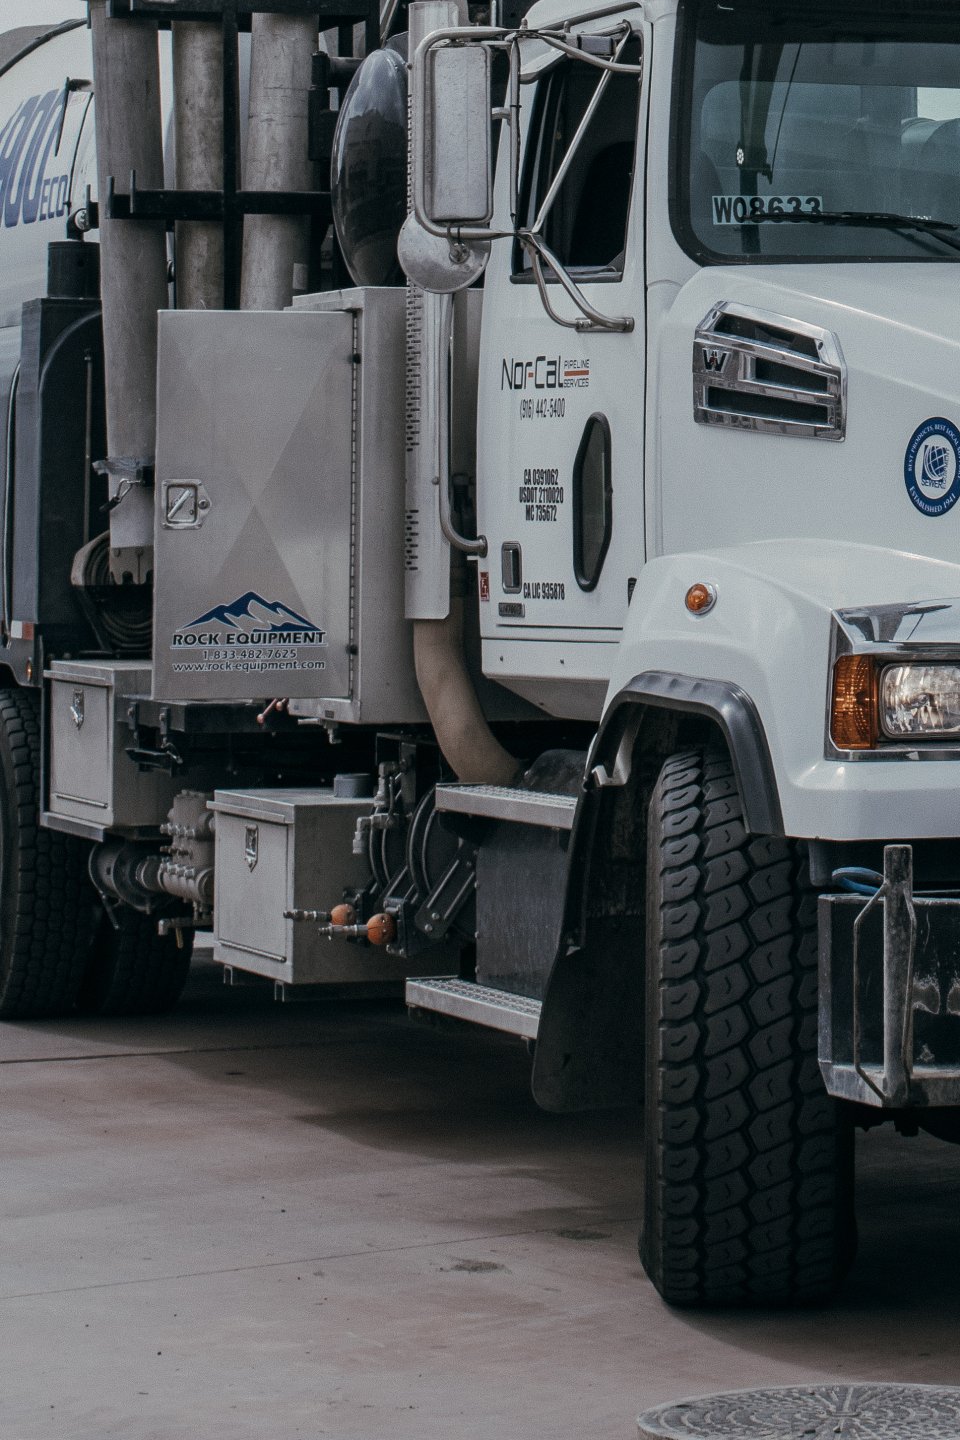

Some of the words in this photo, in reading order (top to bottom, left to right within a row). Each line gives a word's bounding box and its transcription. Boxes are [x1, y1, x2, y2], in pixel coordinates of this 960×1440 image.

[563, 359, 590, 369] PIPELINE
[563, 378, 590, 388] SERVICES
[536, 397, 566, 418] 442-5400
[523, 468, 532, 486] CA
[519, 486, 538, 504] USDOT
[909, 486, 943, 513] ESTABLISHED
[525, 504, 535, 521] MC
[523, 582, 532, 599] CA
[532, 582, 541, 599] LIC
[541, 582, 565, 601] 935878
[172, 632, 220, 646] ROCK
[225, 631, 327, 645] EQUIPMENT
[202, 648, 298, 660] 1.833.482.7625
[172, 660, 326, 673] www.rock-equipment.com
